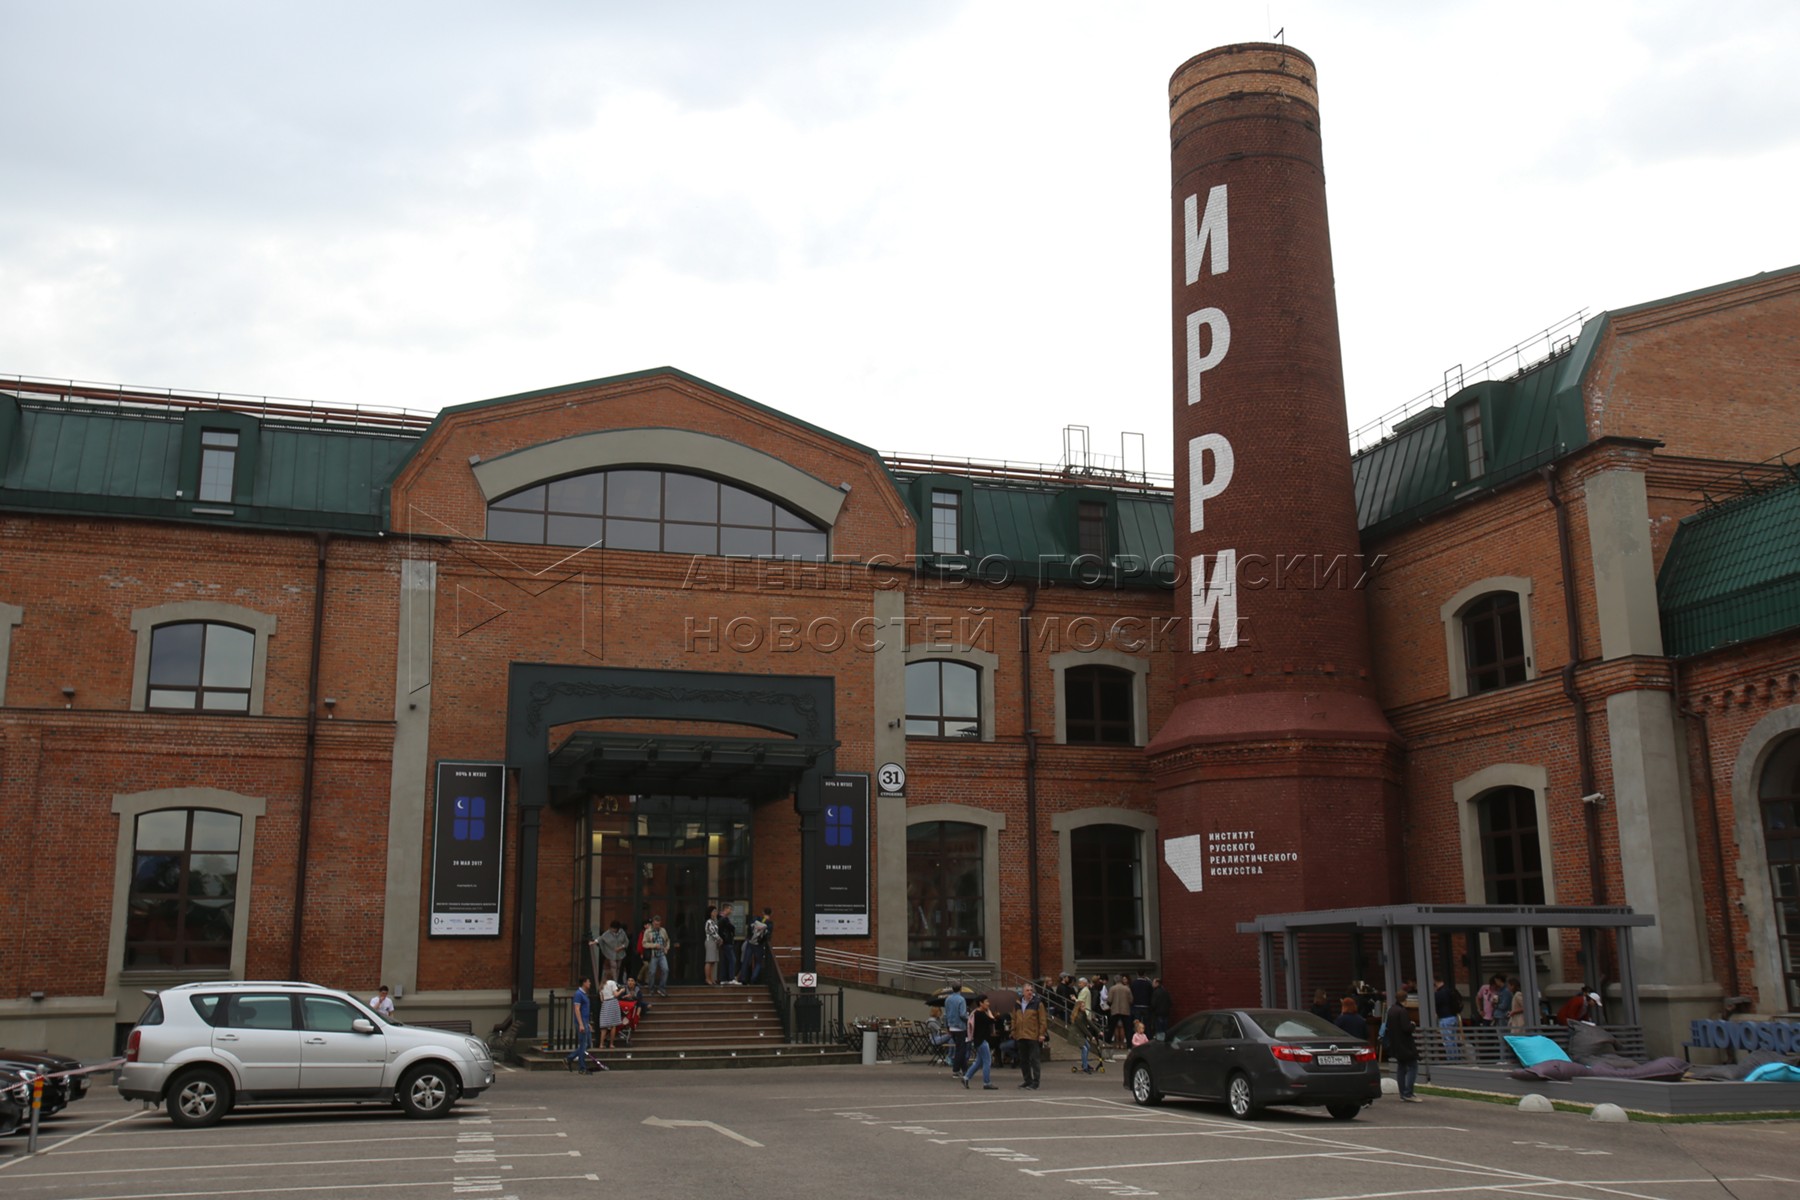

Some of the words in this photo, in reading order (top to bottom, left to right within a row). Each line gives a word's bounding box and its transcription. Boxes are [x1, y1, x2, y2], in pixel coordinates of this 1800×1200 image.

[1184, 183, 1238, 655] ИРРИ
[882, 770, 901, 785] 31
[1208, 831, 1255, 841] ИНСТИТУТ
[1209, 843, 1256, 853] РУССКОГО
[1209, 853, 1298, 864] РЕАЛИСТИЧЕСКОГО
[1210, 866, 1263, 876] ИСКУССТВА
